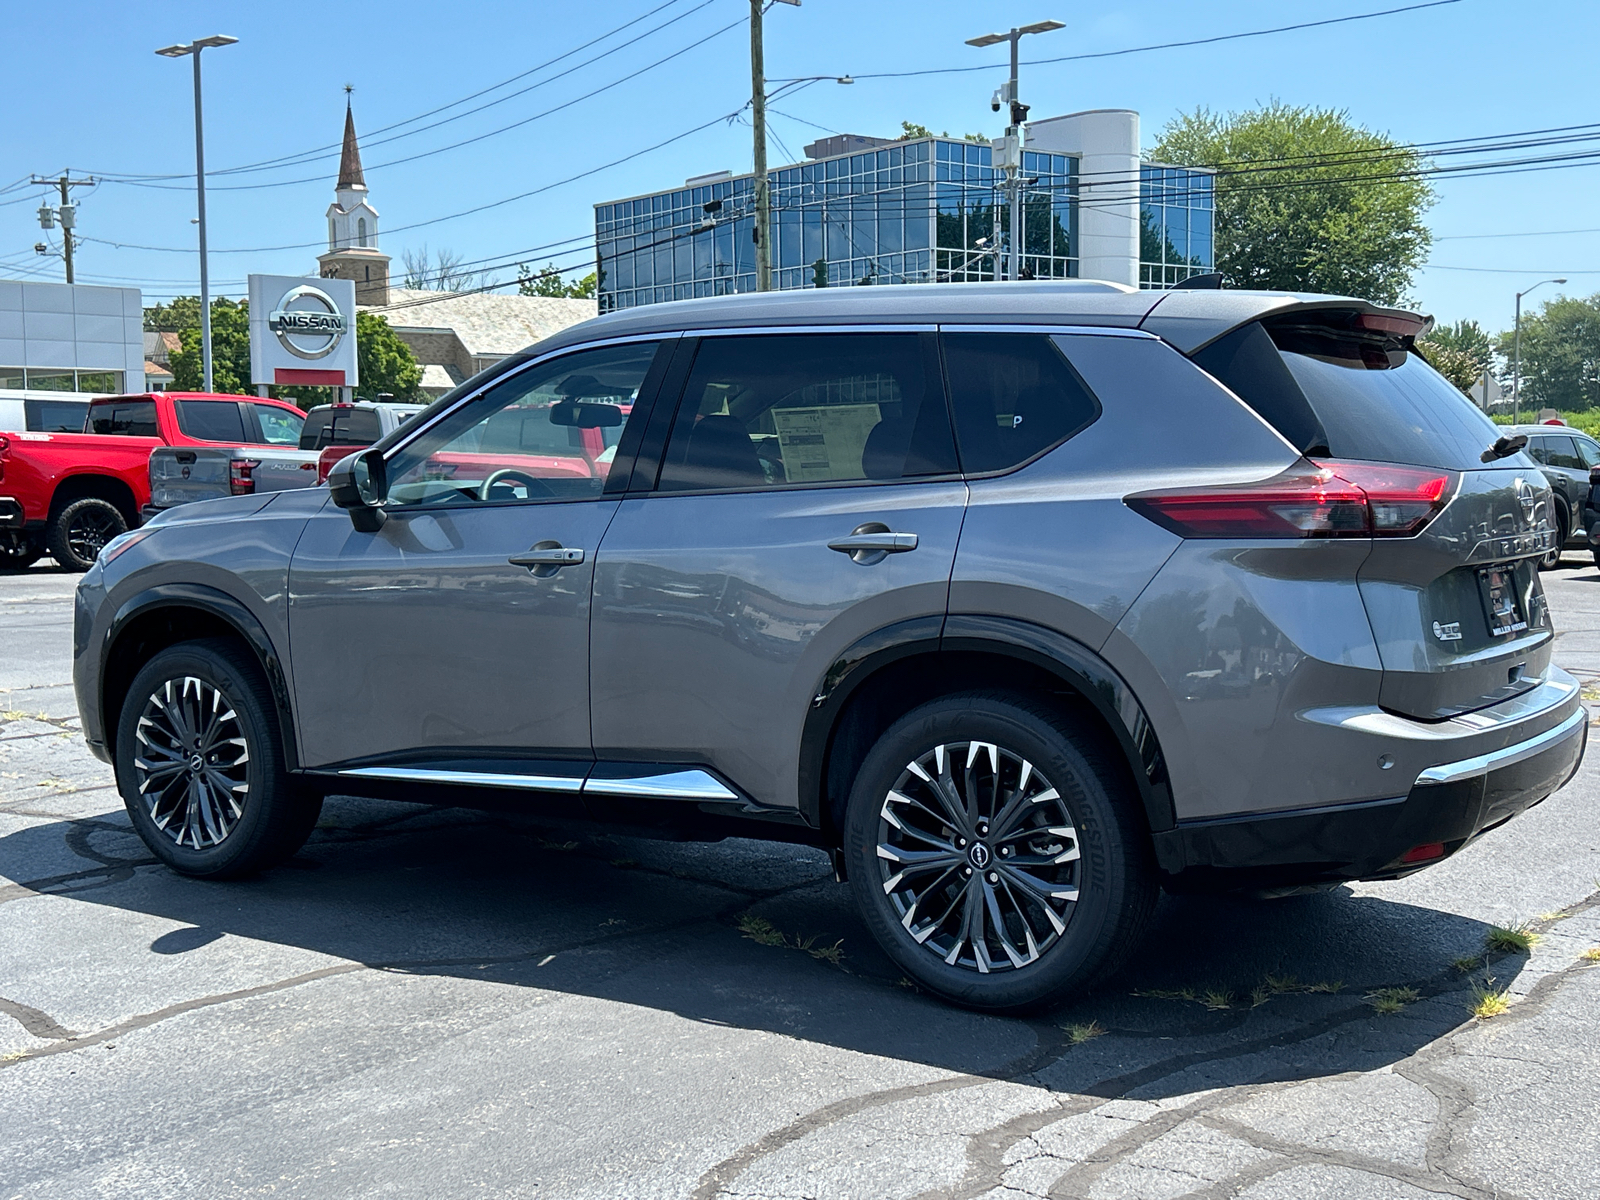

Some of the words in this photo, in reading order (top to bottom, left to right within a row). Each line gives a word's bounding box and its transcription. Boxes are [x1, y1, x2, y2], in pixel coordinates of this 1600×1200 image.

[279, 315, 341, 329] NISSAN
[1501, 533, 1551, 555] ROGUE
[1051, 753, 1107, 895] BRIDGESTONE
